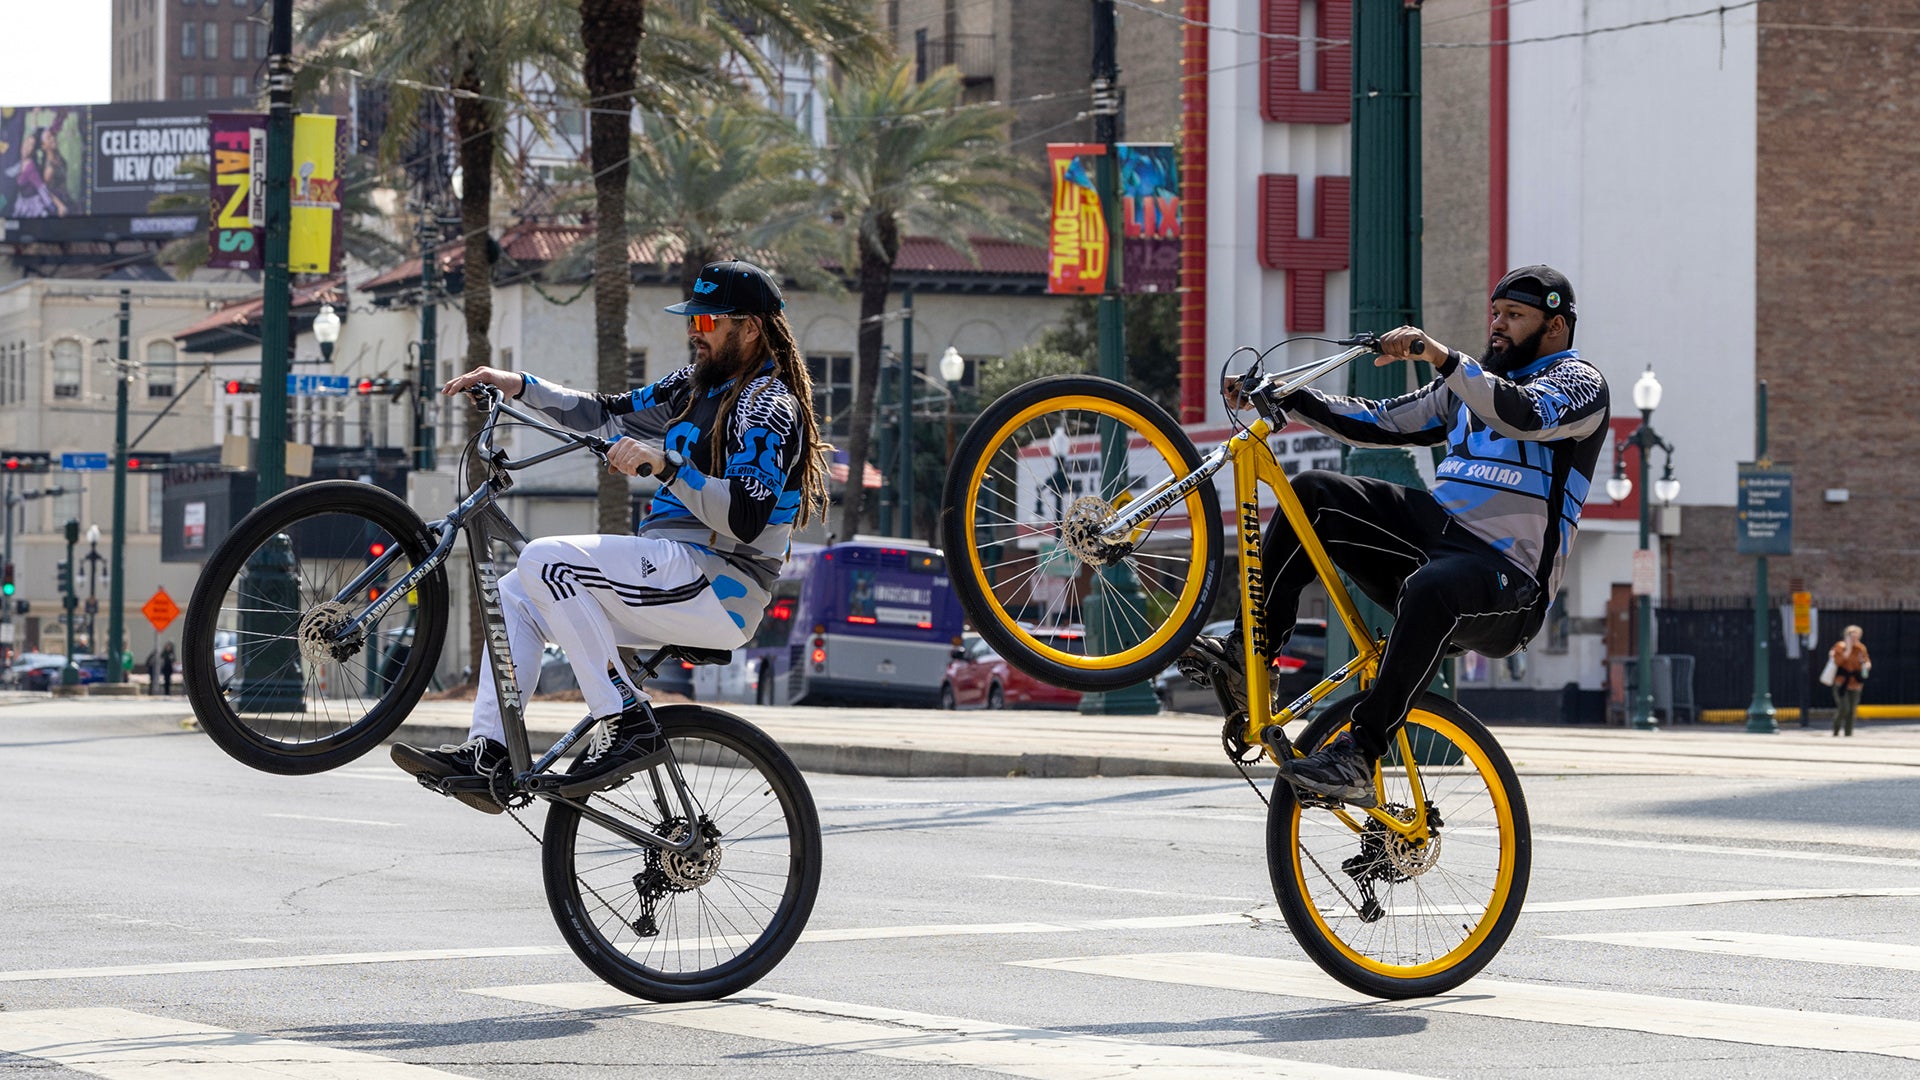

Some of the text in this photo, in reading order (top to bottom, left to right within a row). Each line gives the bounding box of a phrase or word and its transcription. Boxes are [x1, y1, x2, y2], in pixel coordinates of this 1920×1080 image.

[113, 156, 150, 181] NEW
[215, 131, 254, 252] FANS
[1123, 196, 1181, 237] LIX
[737, 465, 758, 475] RIDE
[1464, 463, 1523, 486] SQUAD
[1125, 487, 1178, 528] LANDING
[357, 583, 408, 631] LANDING
